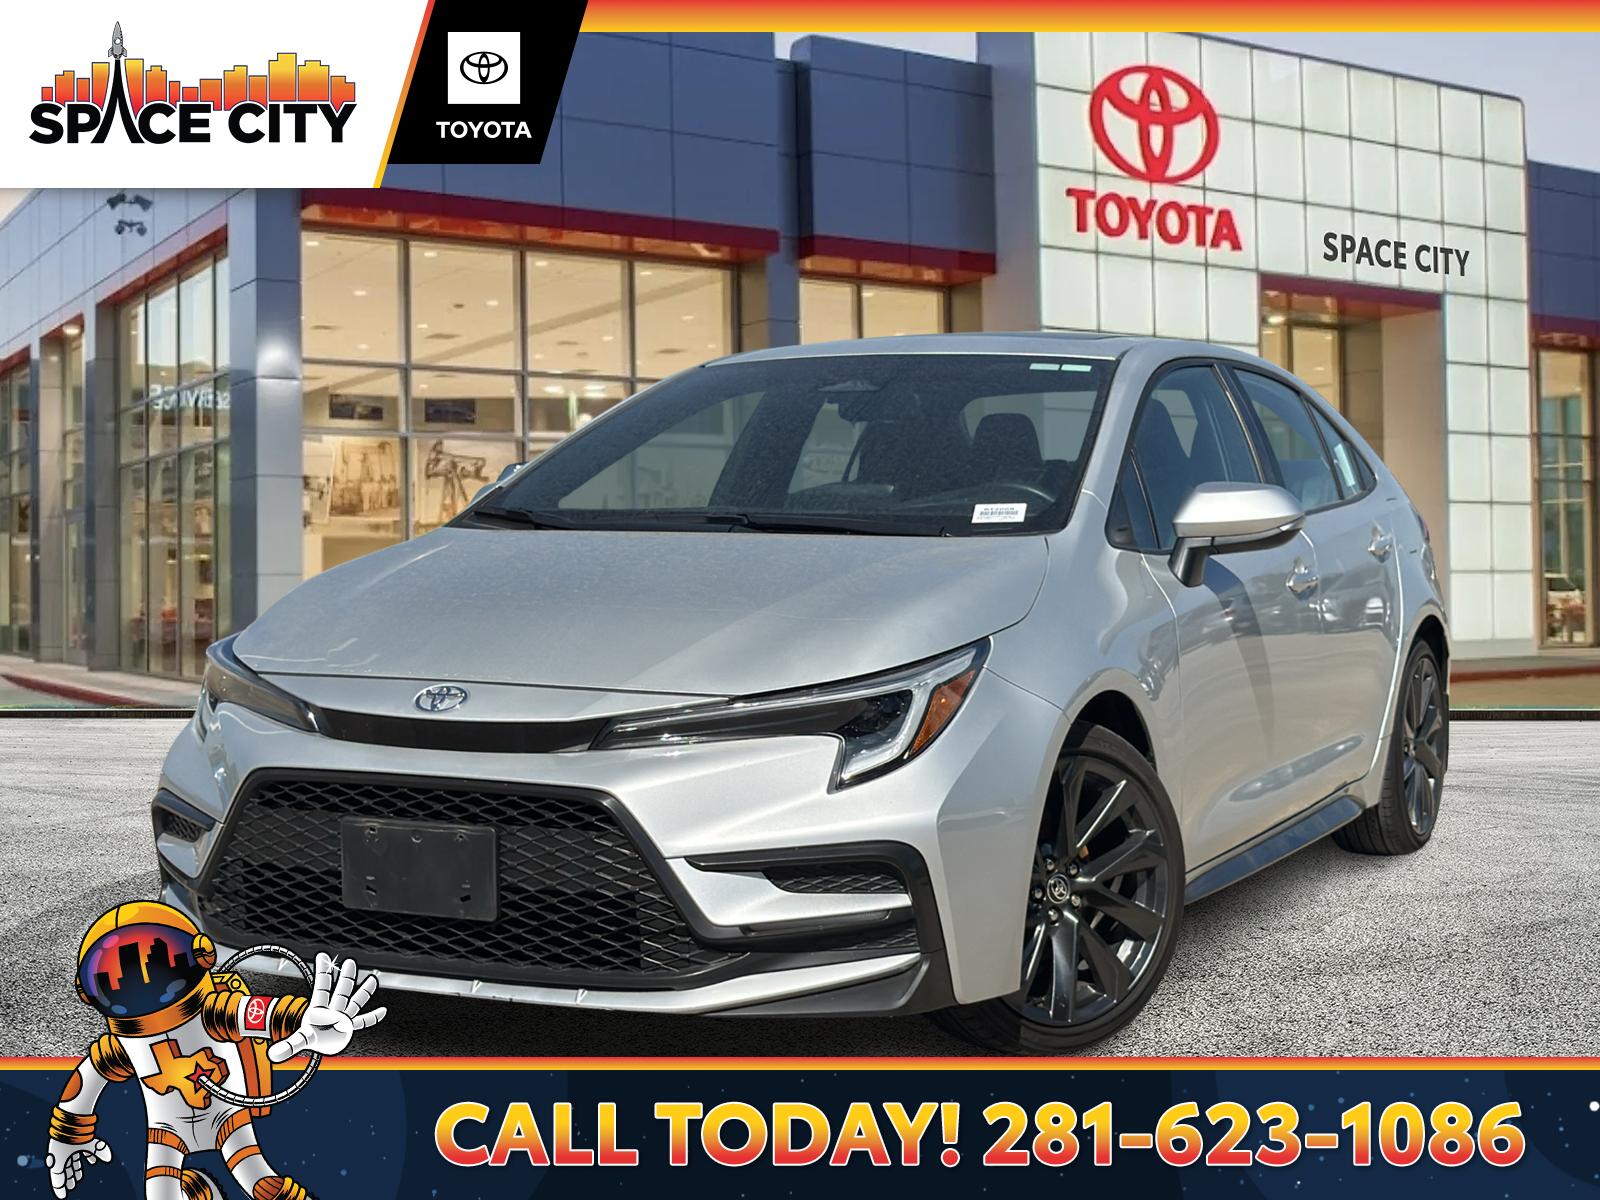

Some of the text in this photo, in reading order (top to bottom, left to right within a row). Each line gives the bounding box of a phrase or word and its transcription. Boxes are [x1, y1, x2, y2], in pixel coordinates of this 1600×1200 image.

[1066, 188, 1242, 250] TOYOTA
[1323, 232, 1470, 277] SPACE CITY
